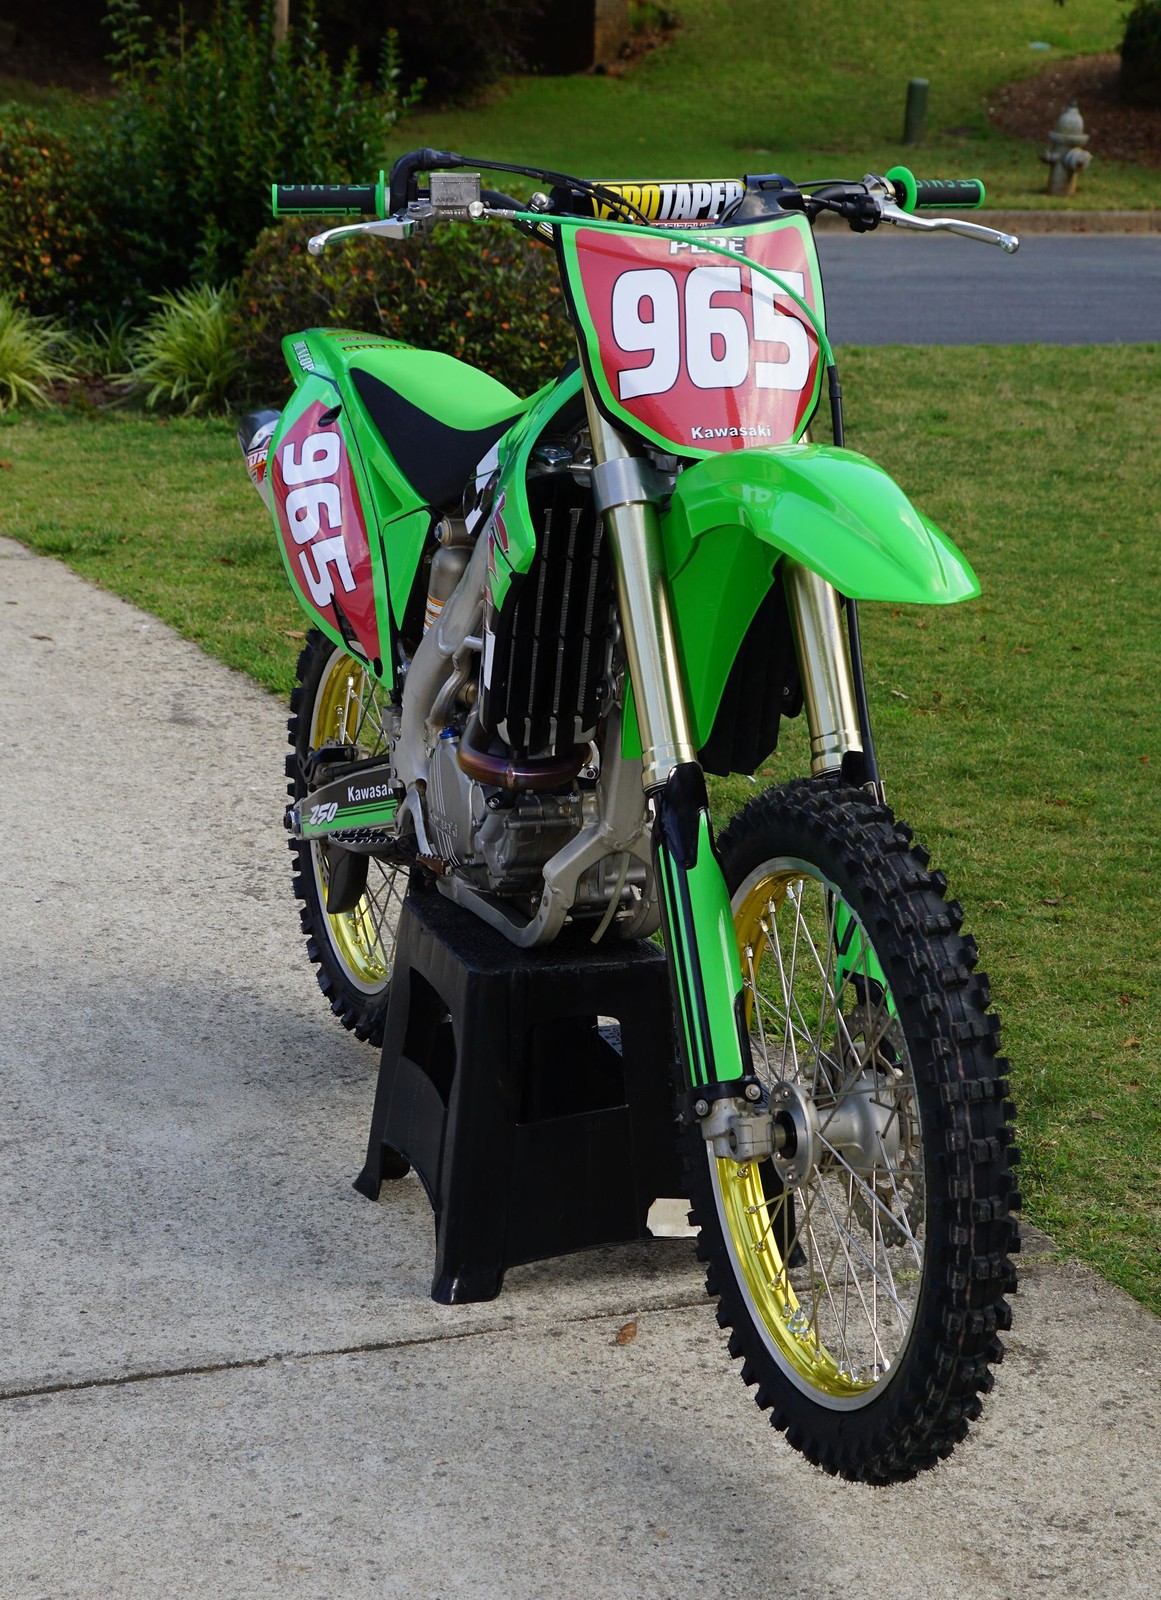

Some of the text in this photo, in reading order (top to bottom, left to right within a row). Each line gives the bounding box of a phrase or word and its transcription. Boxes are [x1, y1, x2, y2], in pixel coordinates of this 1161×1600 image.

[611, 266, 810, 401] 965
[691, 425, 772, 439] Kawasaki
[282, 431, 357, 607] 965
[309, 802, 339, 826] 250
